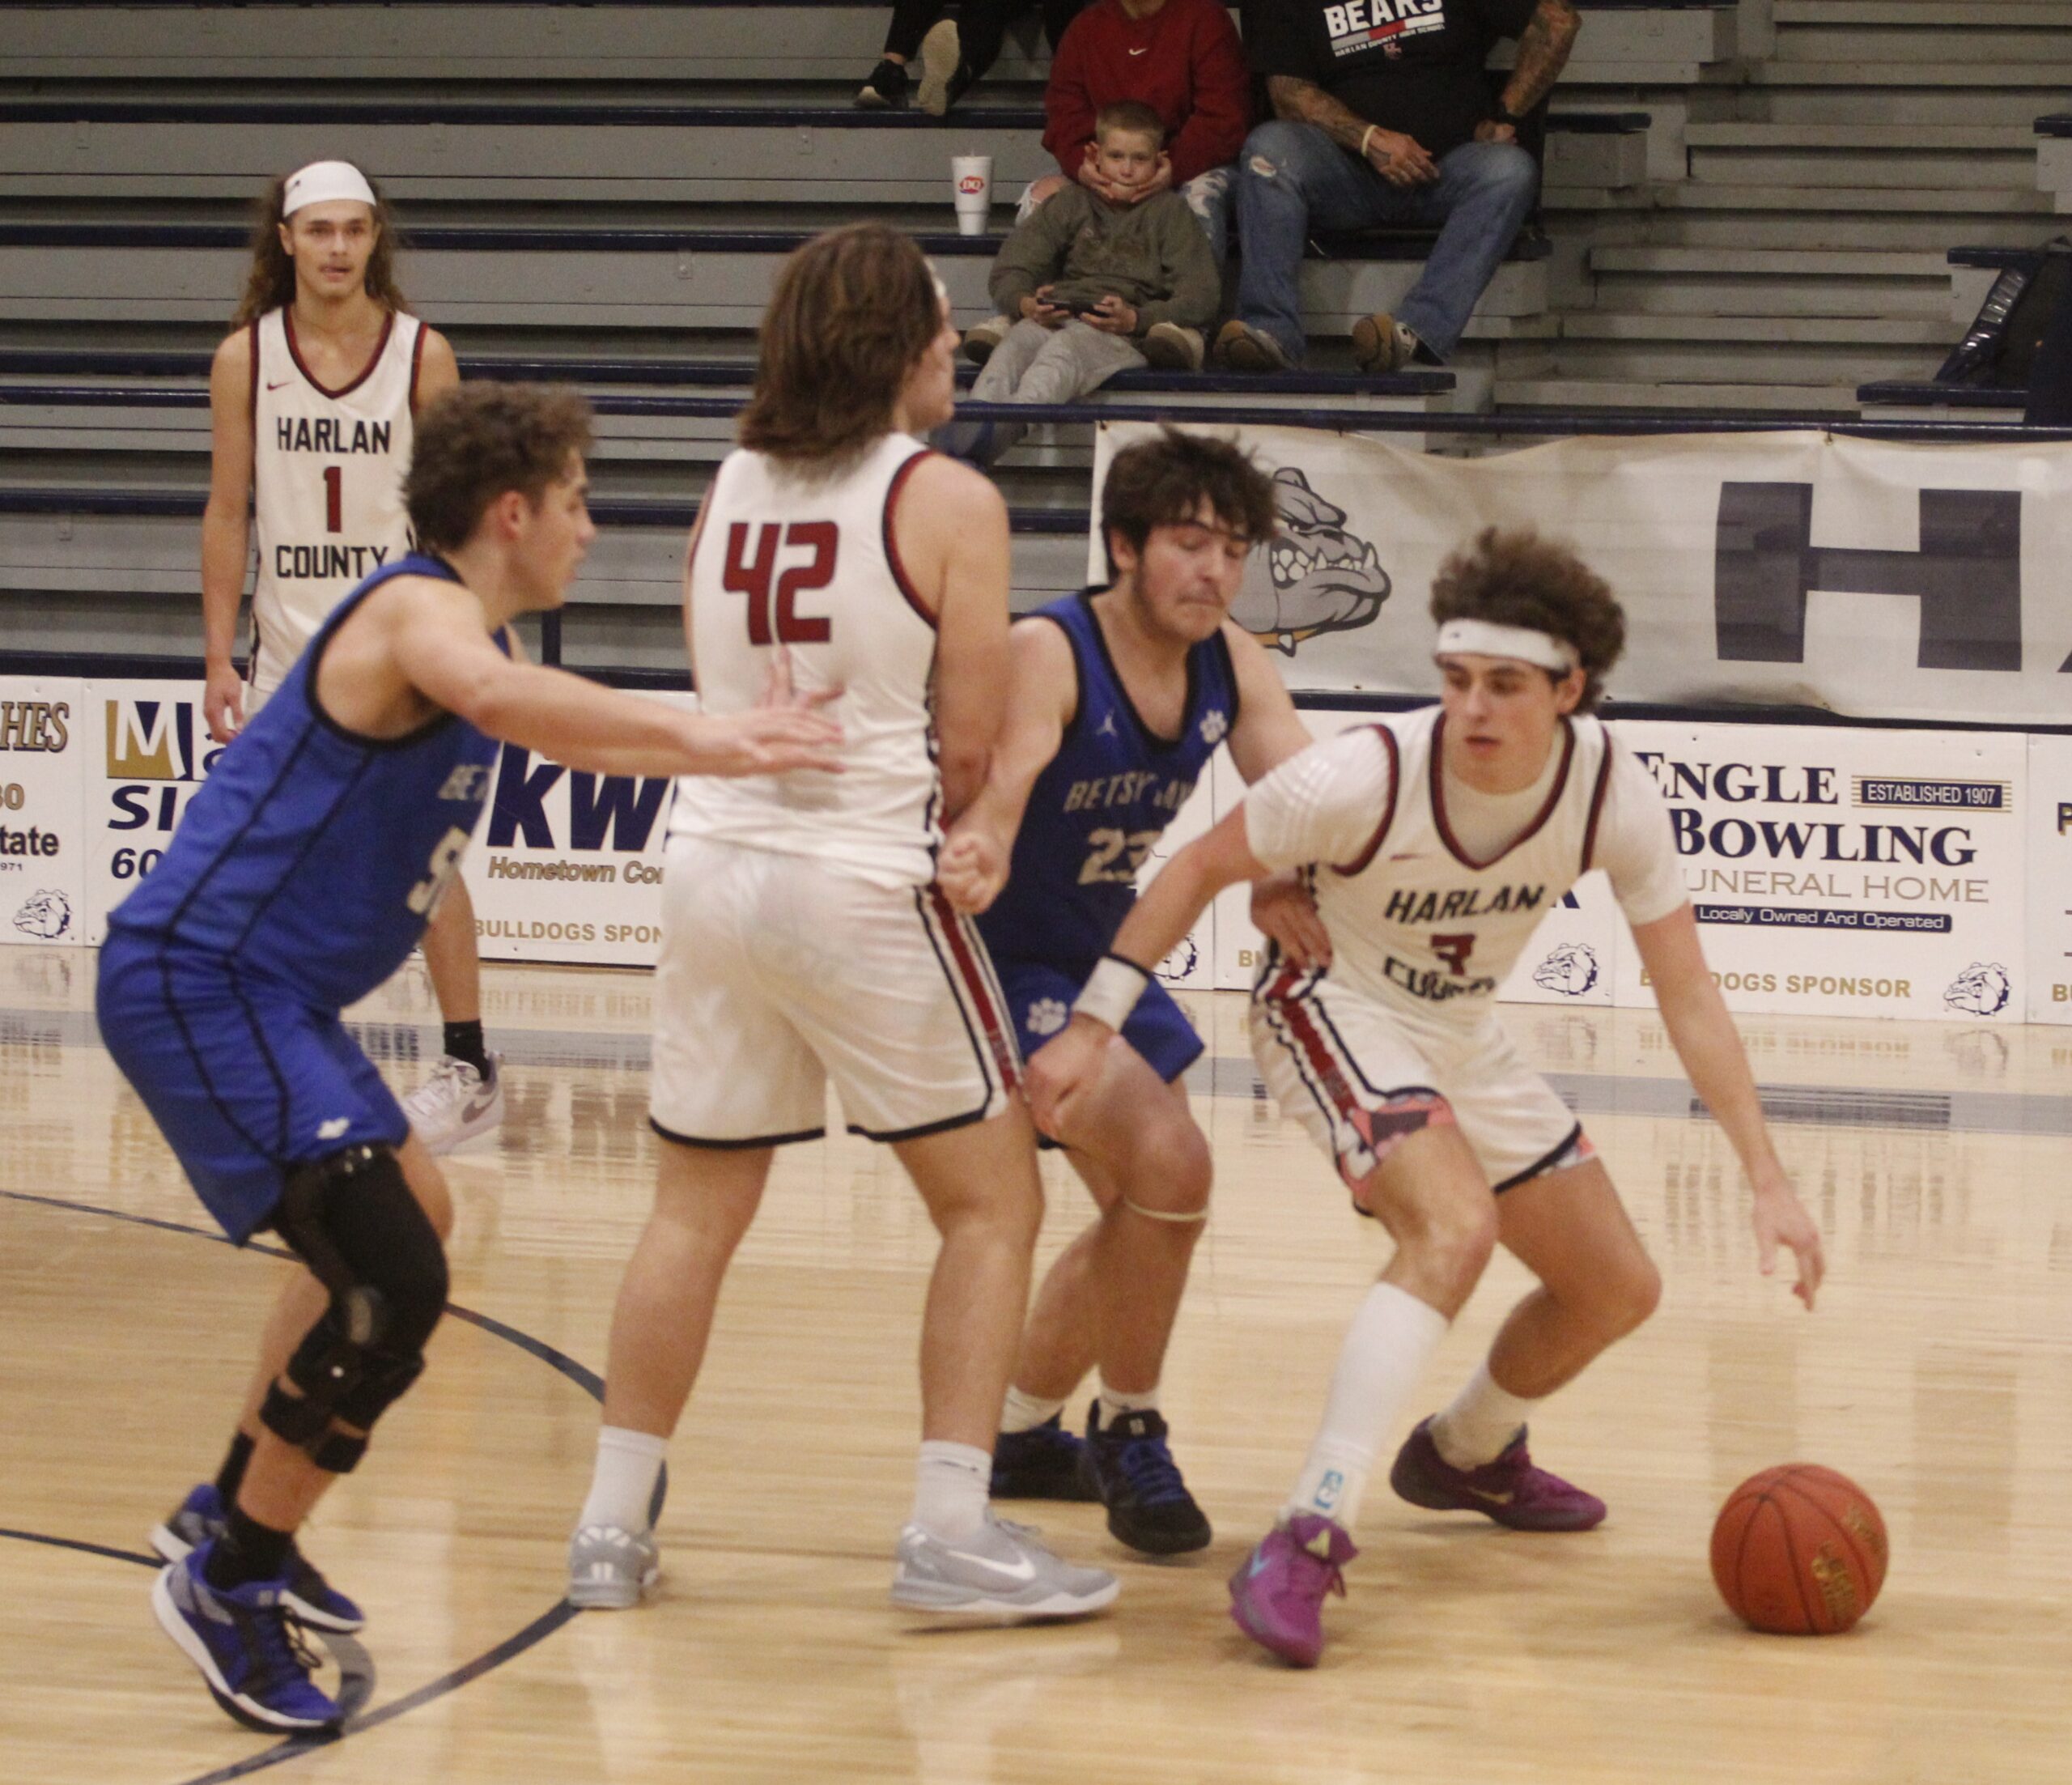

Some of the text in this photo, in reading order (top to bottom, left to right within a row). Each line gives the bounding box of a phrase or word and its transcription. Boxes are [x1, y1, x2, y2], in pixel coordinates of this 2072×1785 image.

[277, 415, 391, 455] HARLAN
[324, 466, 342, 533] 1
[276, 545, 388, 579] COUNTY
[1715, 481, 2072, 672] H
[723, 521, 839, 646] 42
[1867, 784, 1996, 805] ESTABLISHED 1907
[1667, 807, 1978, 866] BOWLING
[488, 856, 616, 882] Hometown
[1385, 883, 1547, 925] HARLAN
[1863, 875, 1989, 903] HOME
[474, 919, 596, 941] BULLDOGS
[1700, 906, 1944, 929] Locally Owned And Operated
[1786, 975, 1911, 998] SPONSOR
